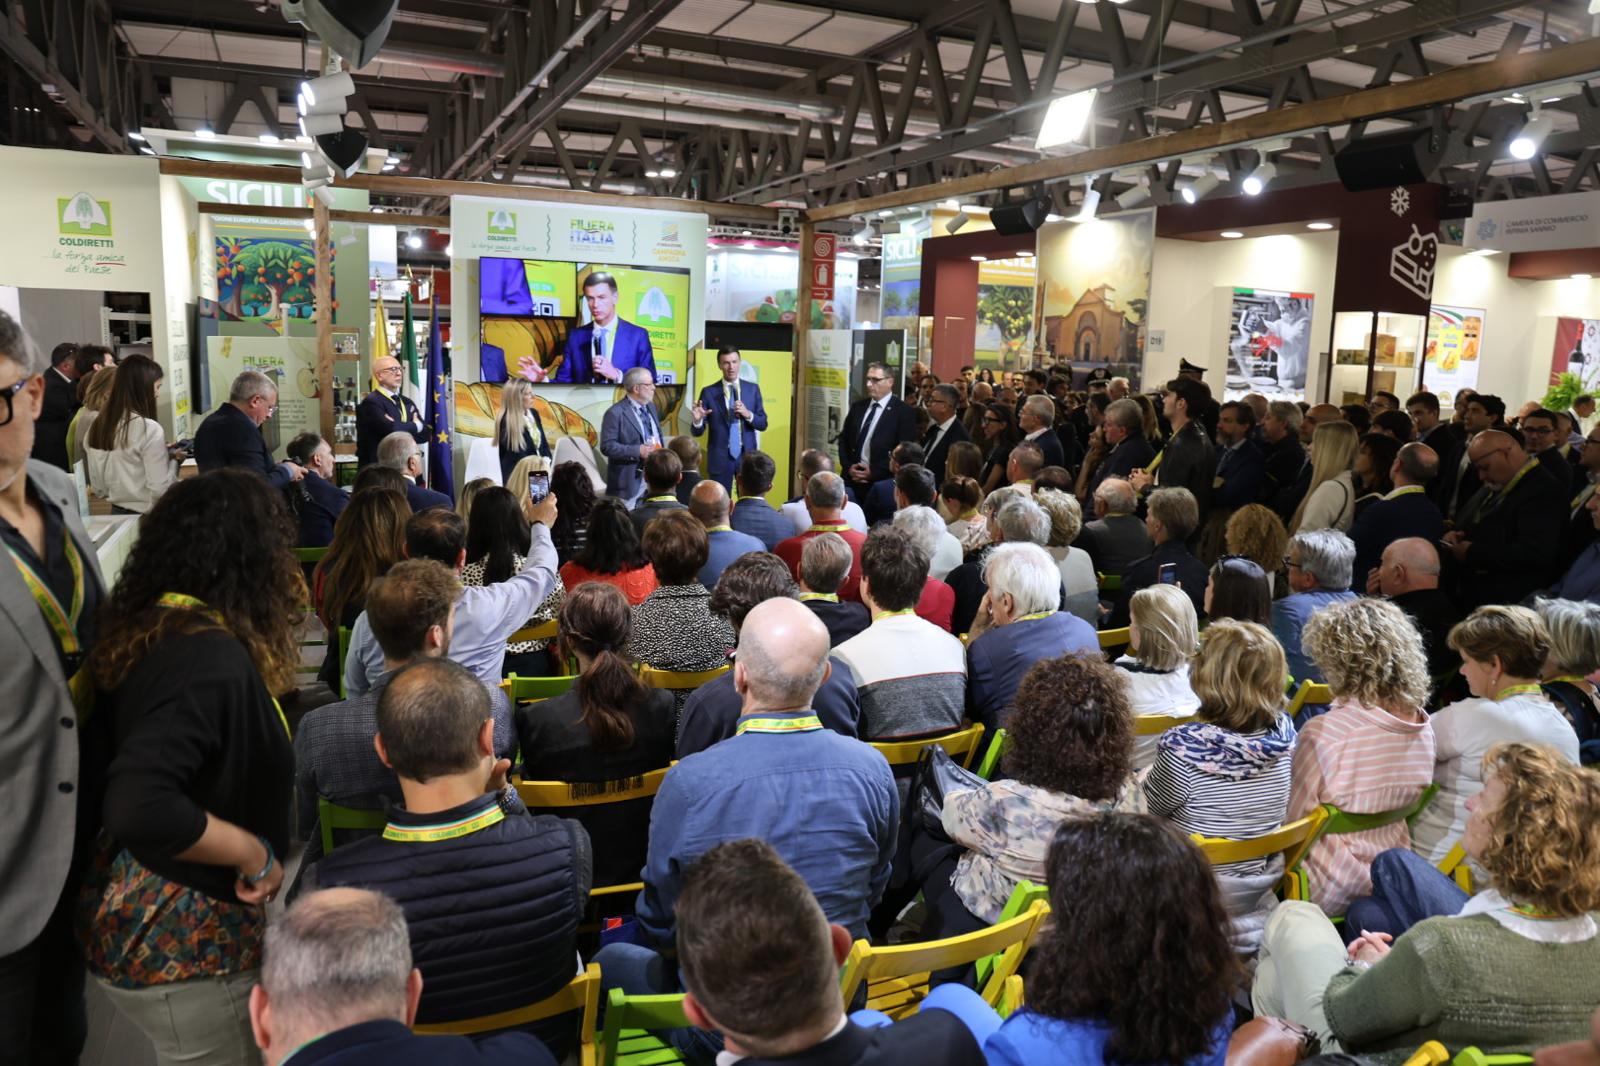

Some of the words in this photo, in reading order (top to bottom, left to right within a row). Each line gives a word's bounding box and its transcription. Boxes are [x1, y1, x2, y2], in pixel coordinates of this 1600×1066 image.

[570, 219, 615, 231] FILIERA
[1505, 219, 1534, 228] CAMERA
[1535, 217, 1542, 225] DI
[1544, 214, 1588, 224] COMMERCIO
[1530, 225, 1556, 233] SANNIO
[570, 230, 615, 244] ITALIA
[59, 238, 114, 248] COLDIRETTI
[65, 251, 94, 264] forza
[96, 253, 126, 262] amica
[65, 264, 80, 273] del
[84, 265, 112, 275] Paese
[243, 356, 285, 366] FILIERA
